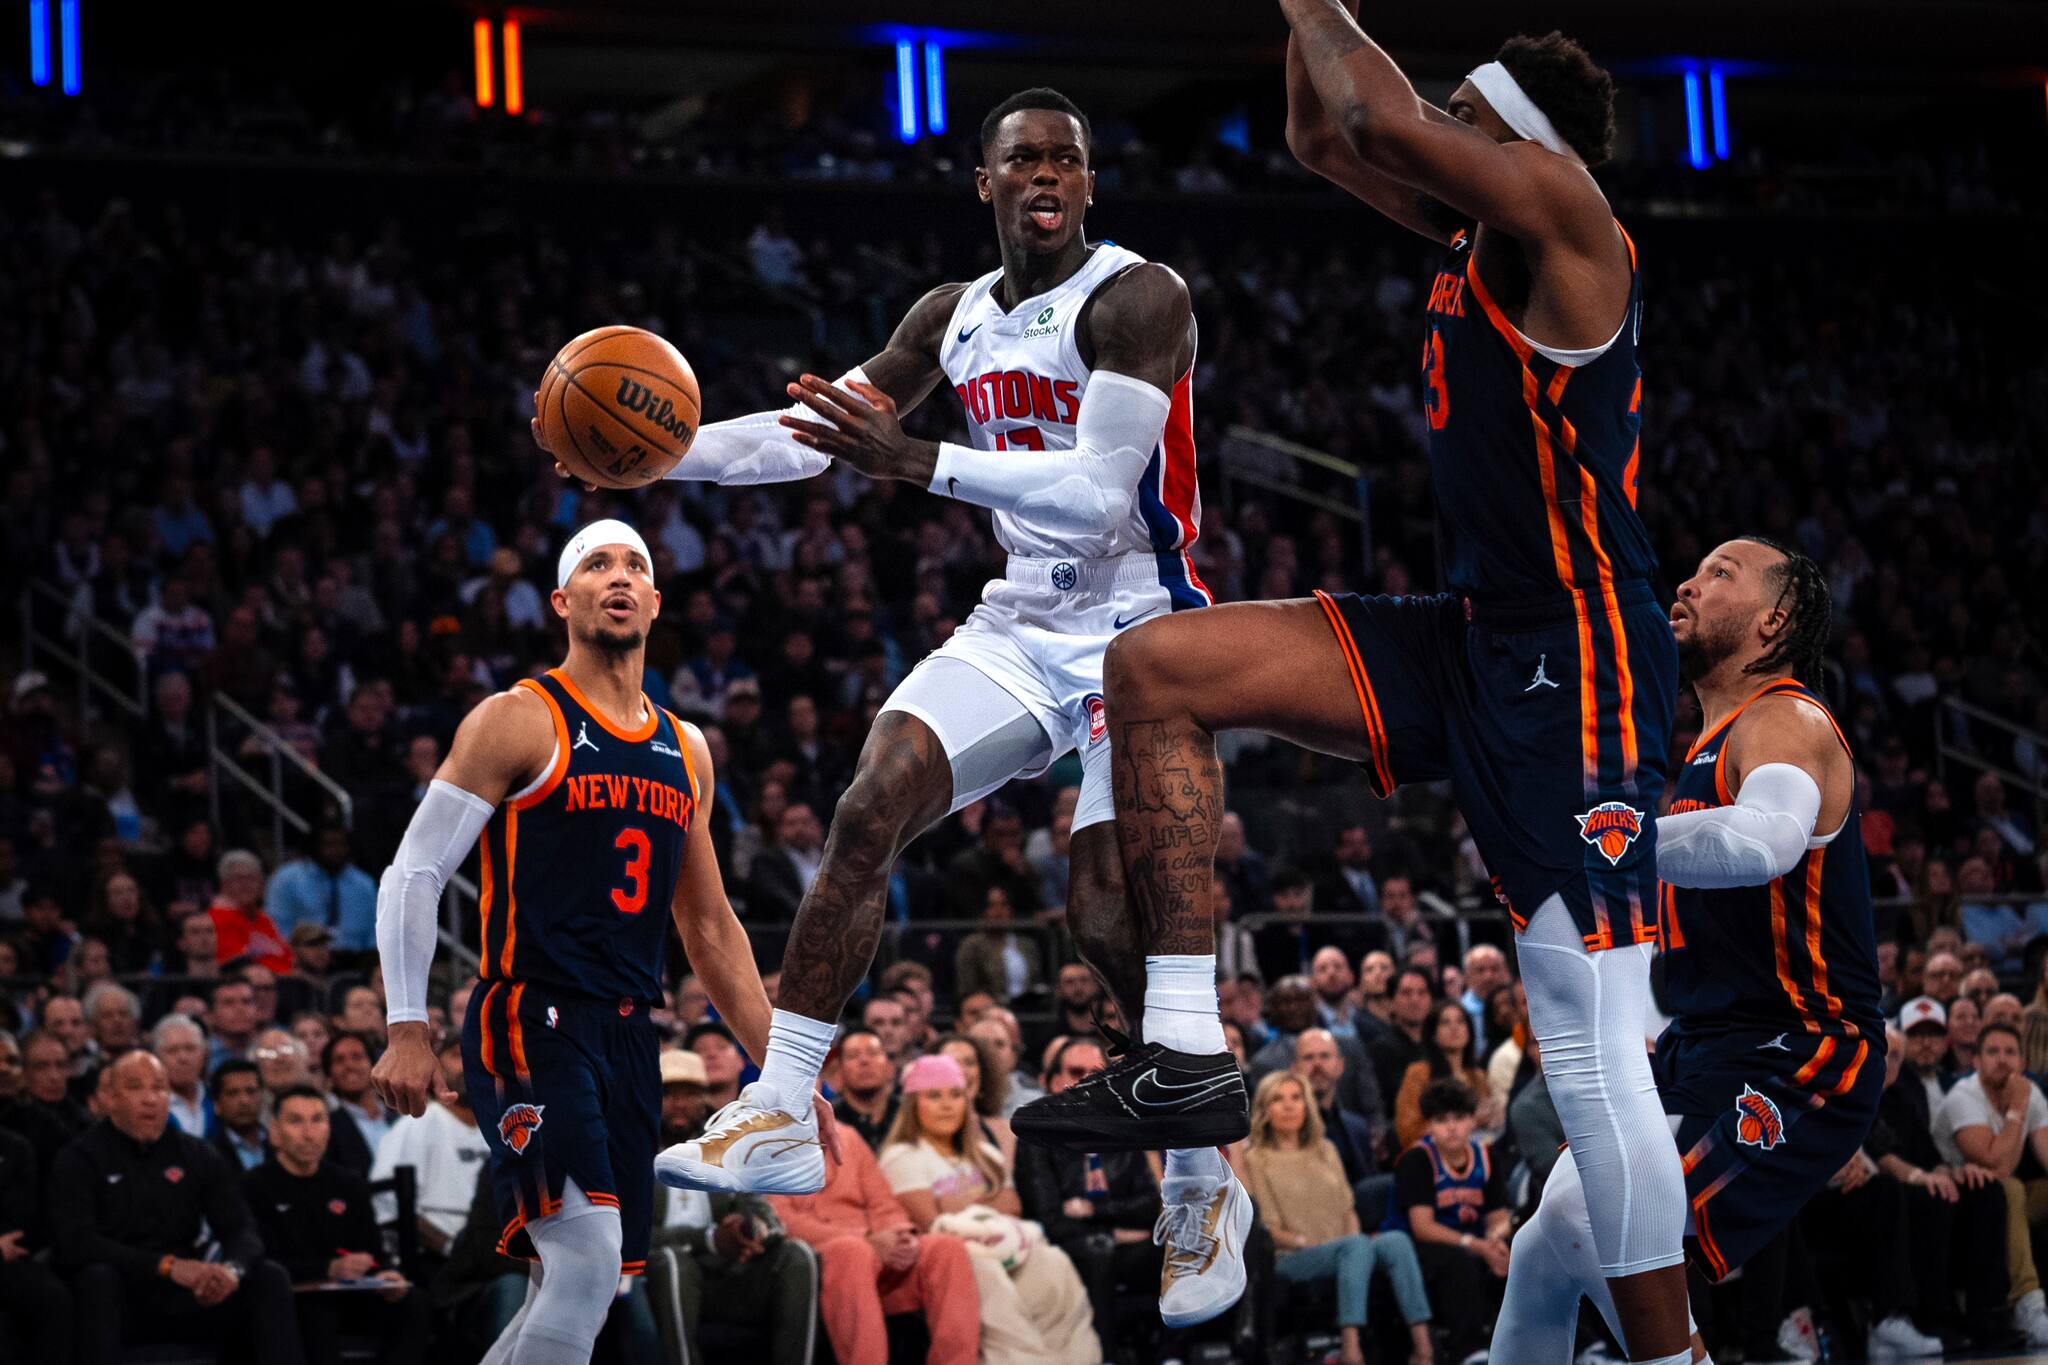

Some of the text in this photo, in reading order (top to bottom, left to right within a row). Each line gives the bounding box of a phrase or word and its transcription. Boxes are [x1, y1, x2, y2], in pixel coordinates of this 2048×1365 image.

[1024, 324, 1059, 338] StockX
[616, 376, 693, 447] Wilson
[1423, 329, 1449, 431] 3
[566, 774, 692, 832] NEW YORK
[1583, 809, 1640, 836] KNICKS
[611, 828, 650, 914] 3
